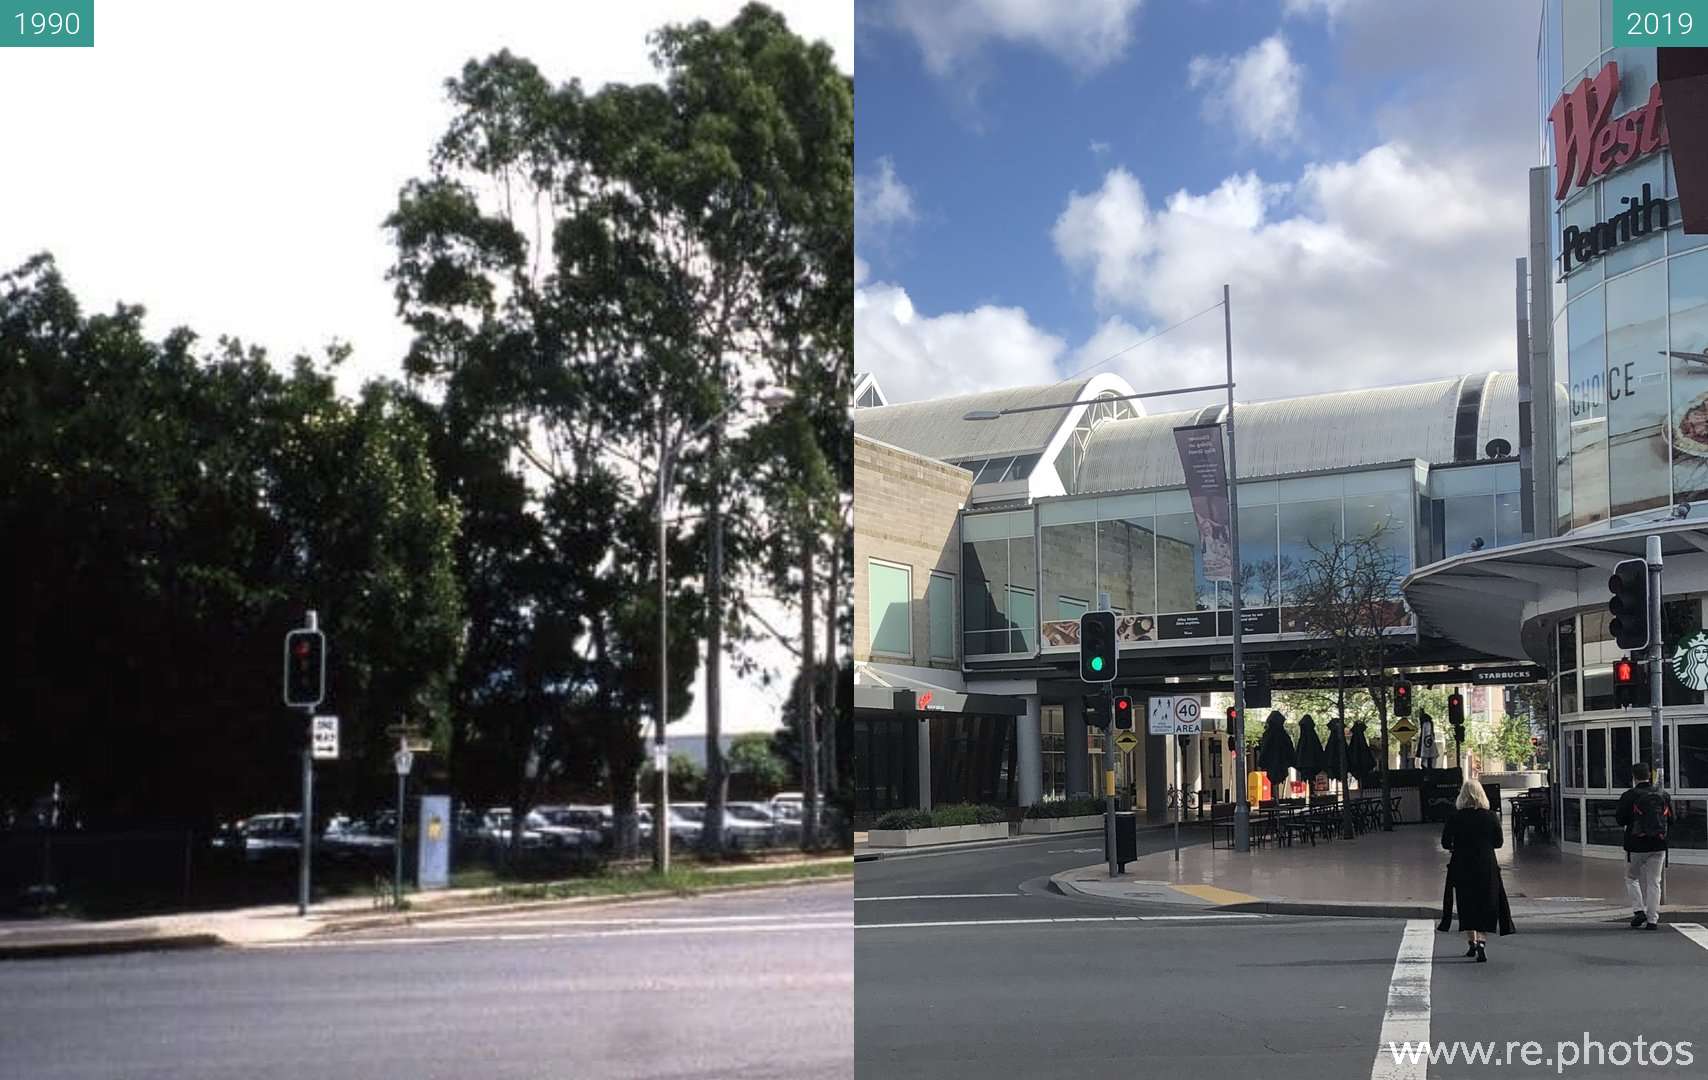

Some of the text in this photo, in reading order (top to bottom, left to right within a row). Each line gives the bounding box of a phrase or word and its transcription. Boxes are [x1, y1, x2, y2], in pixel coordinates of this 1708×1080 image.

[1562, 182, 1668, 272] Penrith
[1572, 361, 1635, 416] CHOICE
[1478, 671, 1531, 680] STARBUCKS
[1178, 703, 1197, 717] 40
[1176, 724, 1201, 732] AREA
